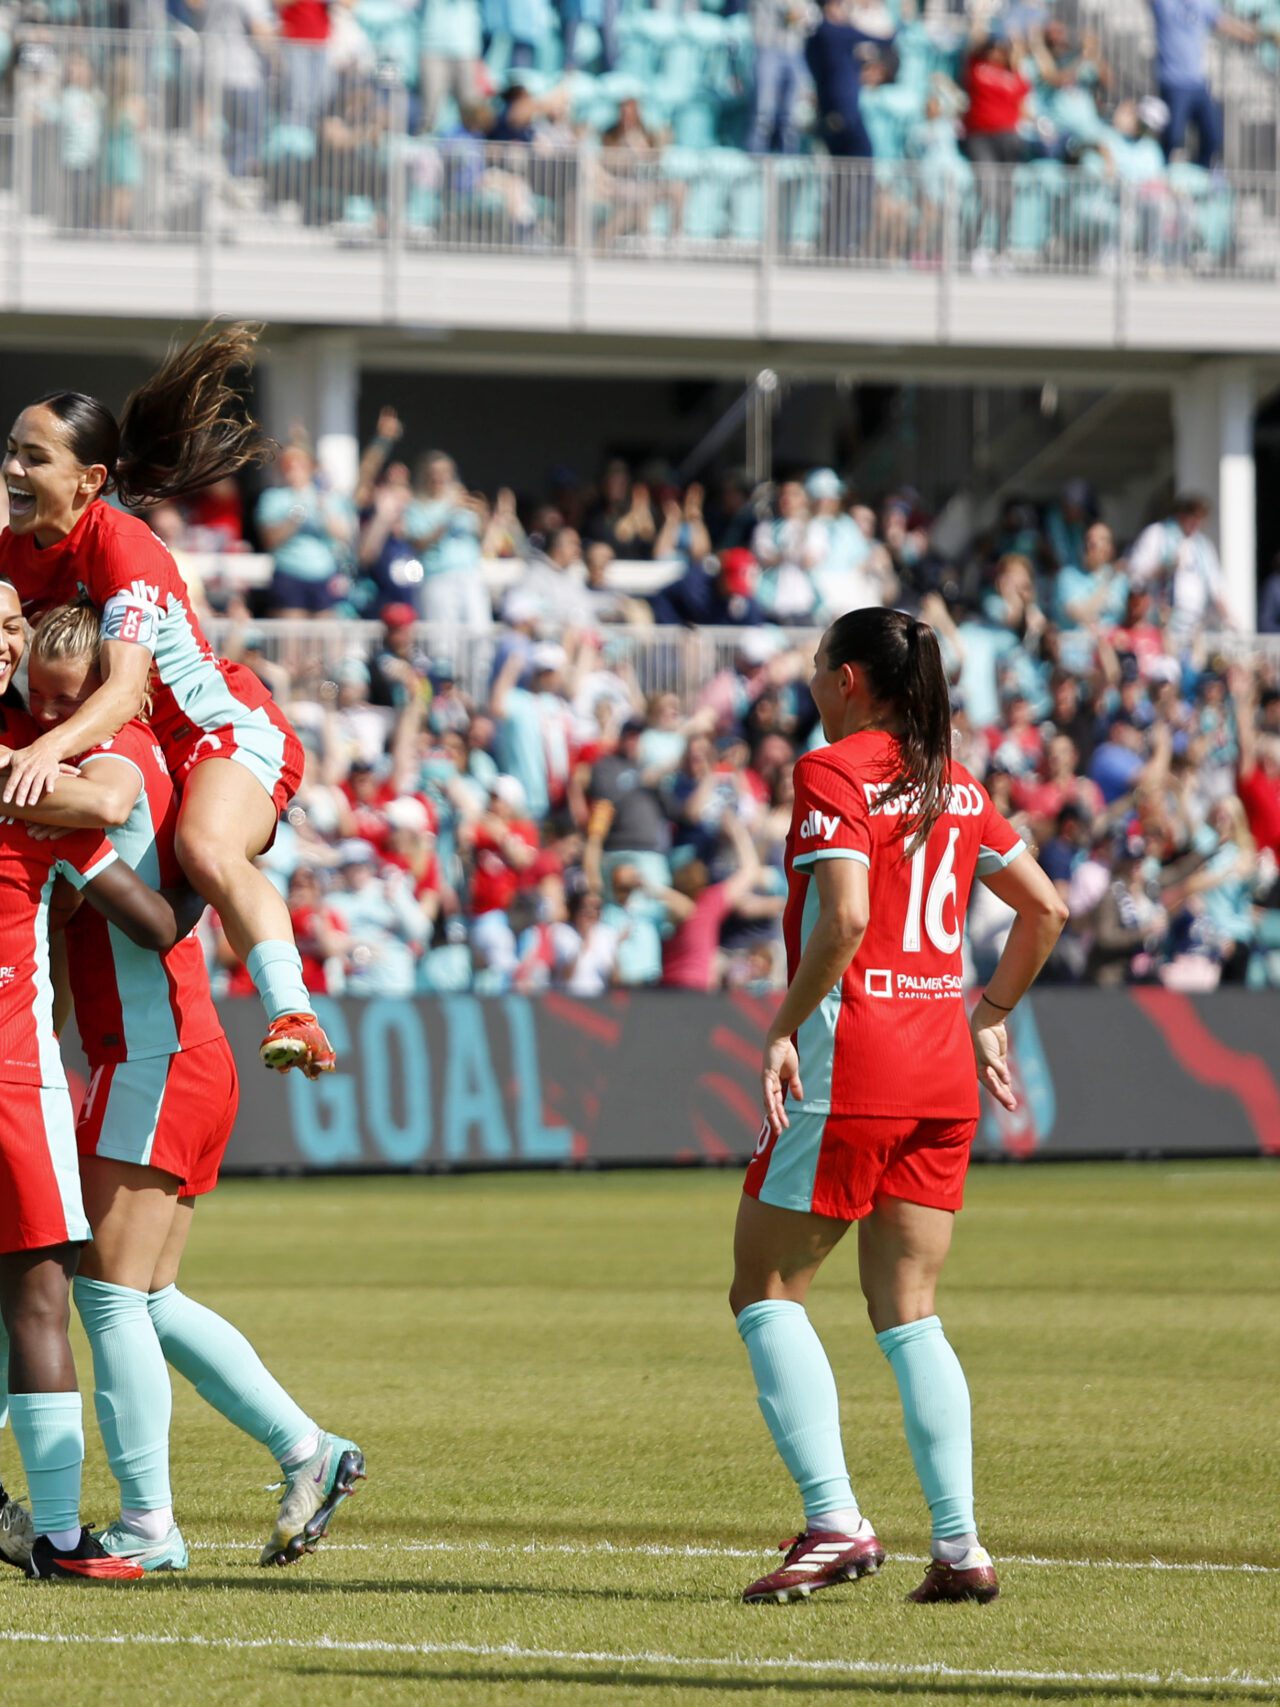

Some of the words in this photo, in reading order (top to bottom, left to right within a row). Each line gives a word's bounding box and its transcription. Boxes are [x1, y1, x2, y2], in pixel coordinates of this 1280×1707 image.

[800, 810, 841, 841] ally
[903, 828, 961, 955] 16
[899, 991, 931, 1000] CAPITAL
[288, 993, 573, 1164] GOAL
